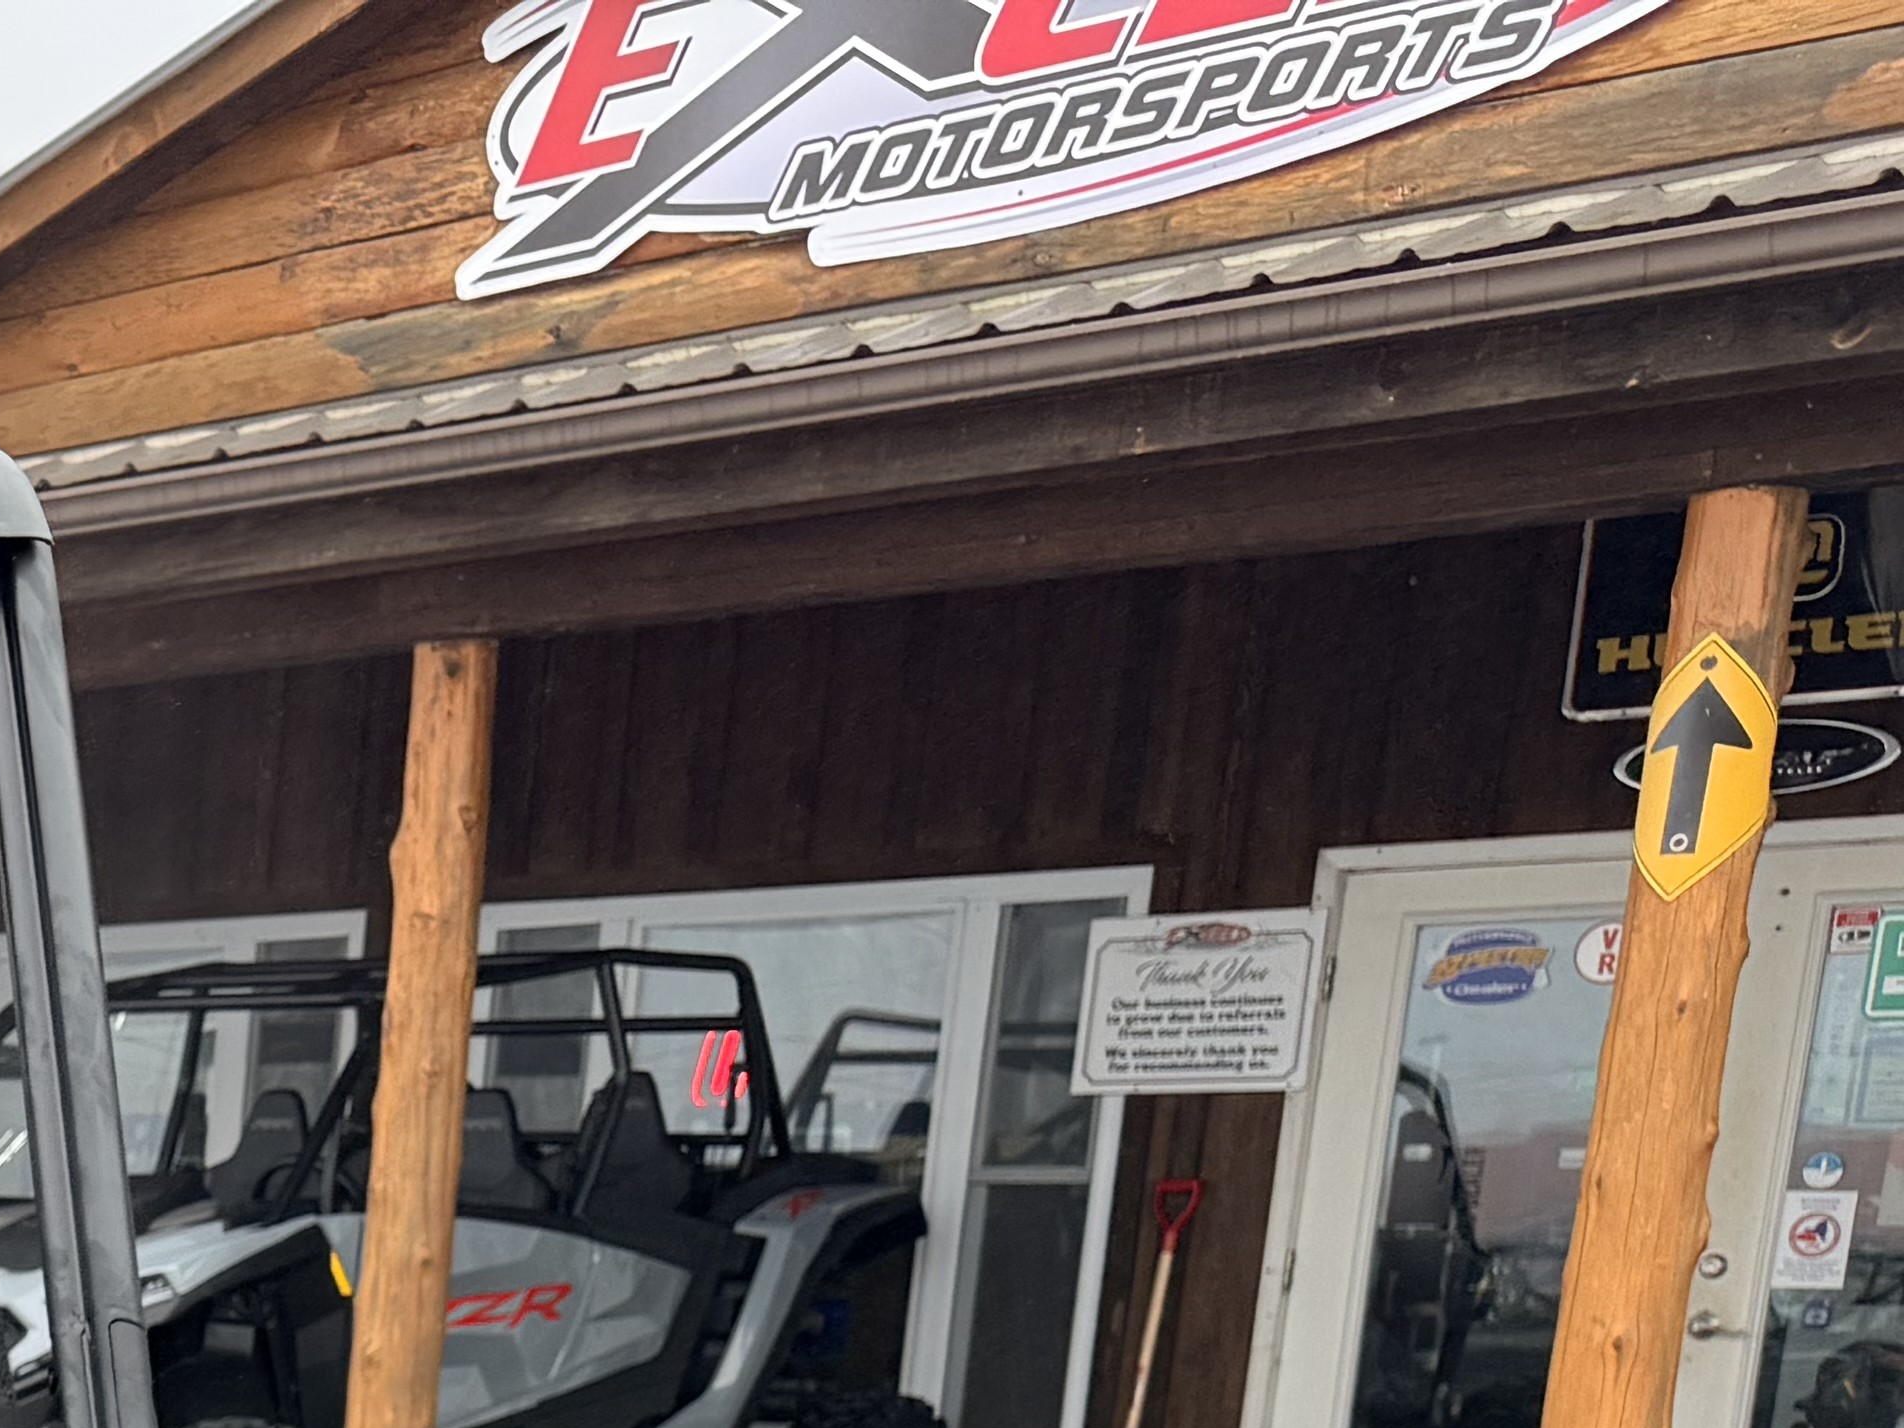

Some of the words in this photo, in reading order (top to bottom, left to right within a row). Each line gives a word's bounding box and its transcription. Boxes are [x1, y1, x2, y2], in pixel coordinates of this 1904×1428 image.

[780, 0, 1554, 204] MOTORSPORTS
[1135, 959, 1209, 991] Thank
[1210, 955, 1269, 995] You
[447, 1283, 573, 1328] ZR
